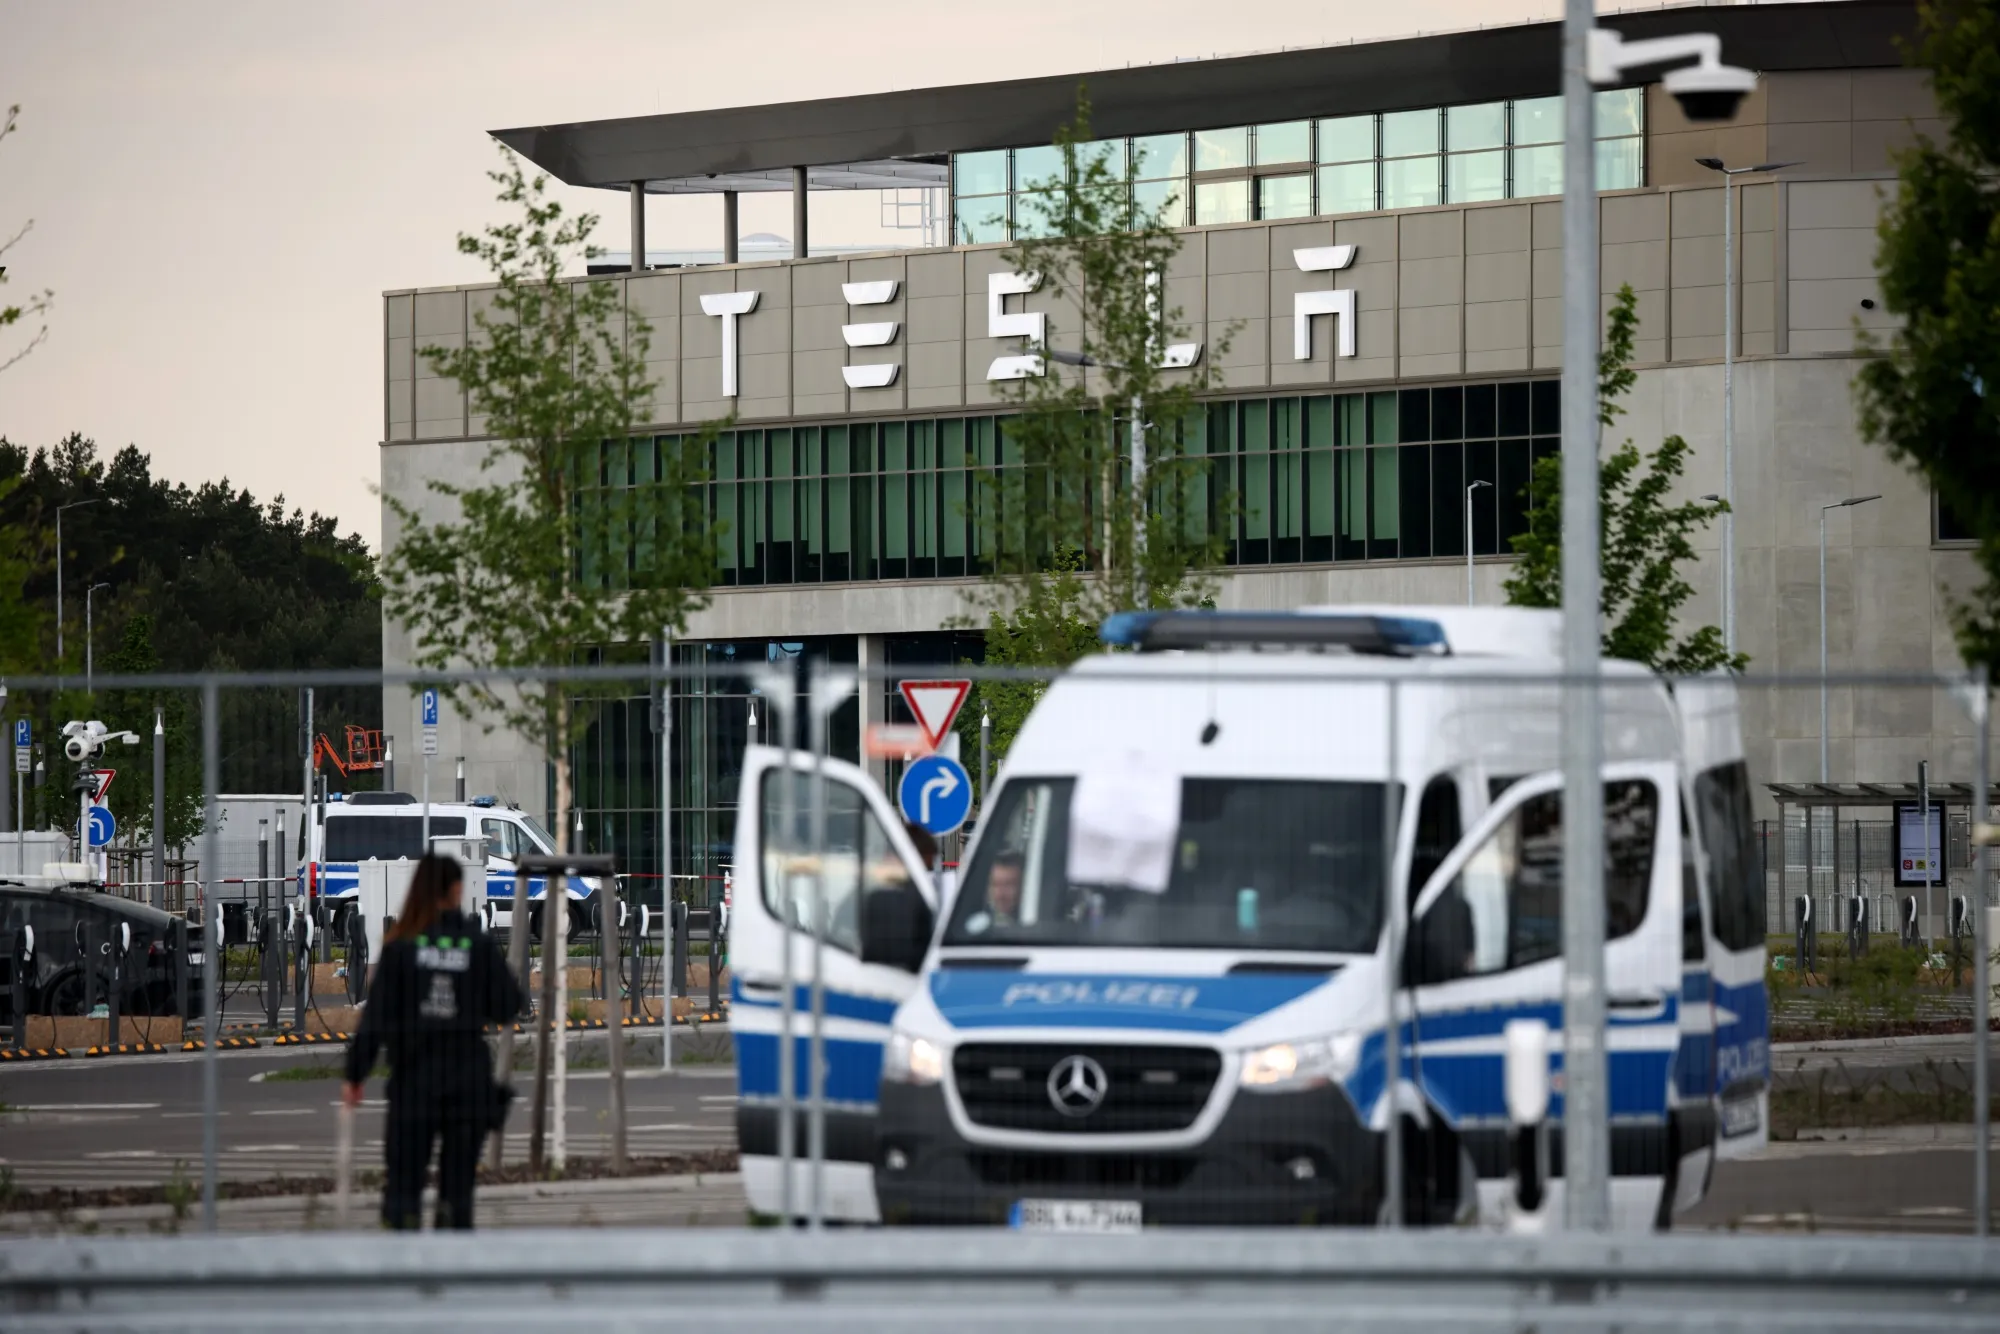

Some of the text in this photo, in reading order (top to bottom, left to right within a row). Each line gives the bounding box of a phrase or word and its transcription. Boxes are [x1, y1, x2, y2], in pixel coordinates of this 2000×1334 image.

[698, 243, 1357, 398] TESLA
[424, 691, 434, 720] P
[18, 719, 27, 742] P
[1002, 980, 1199, 1009] POLIZEI
